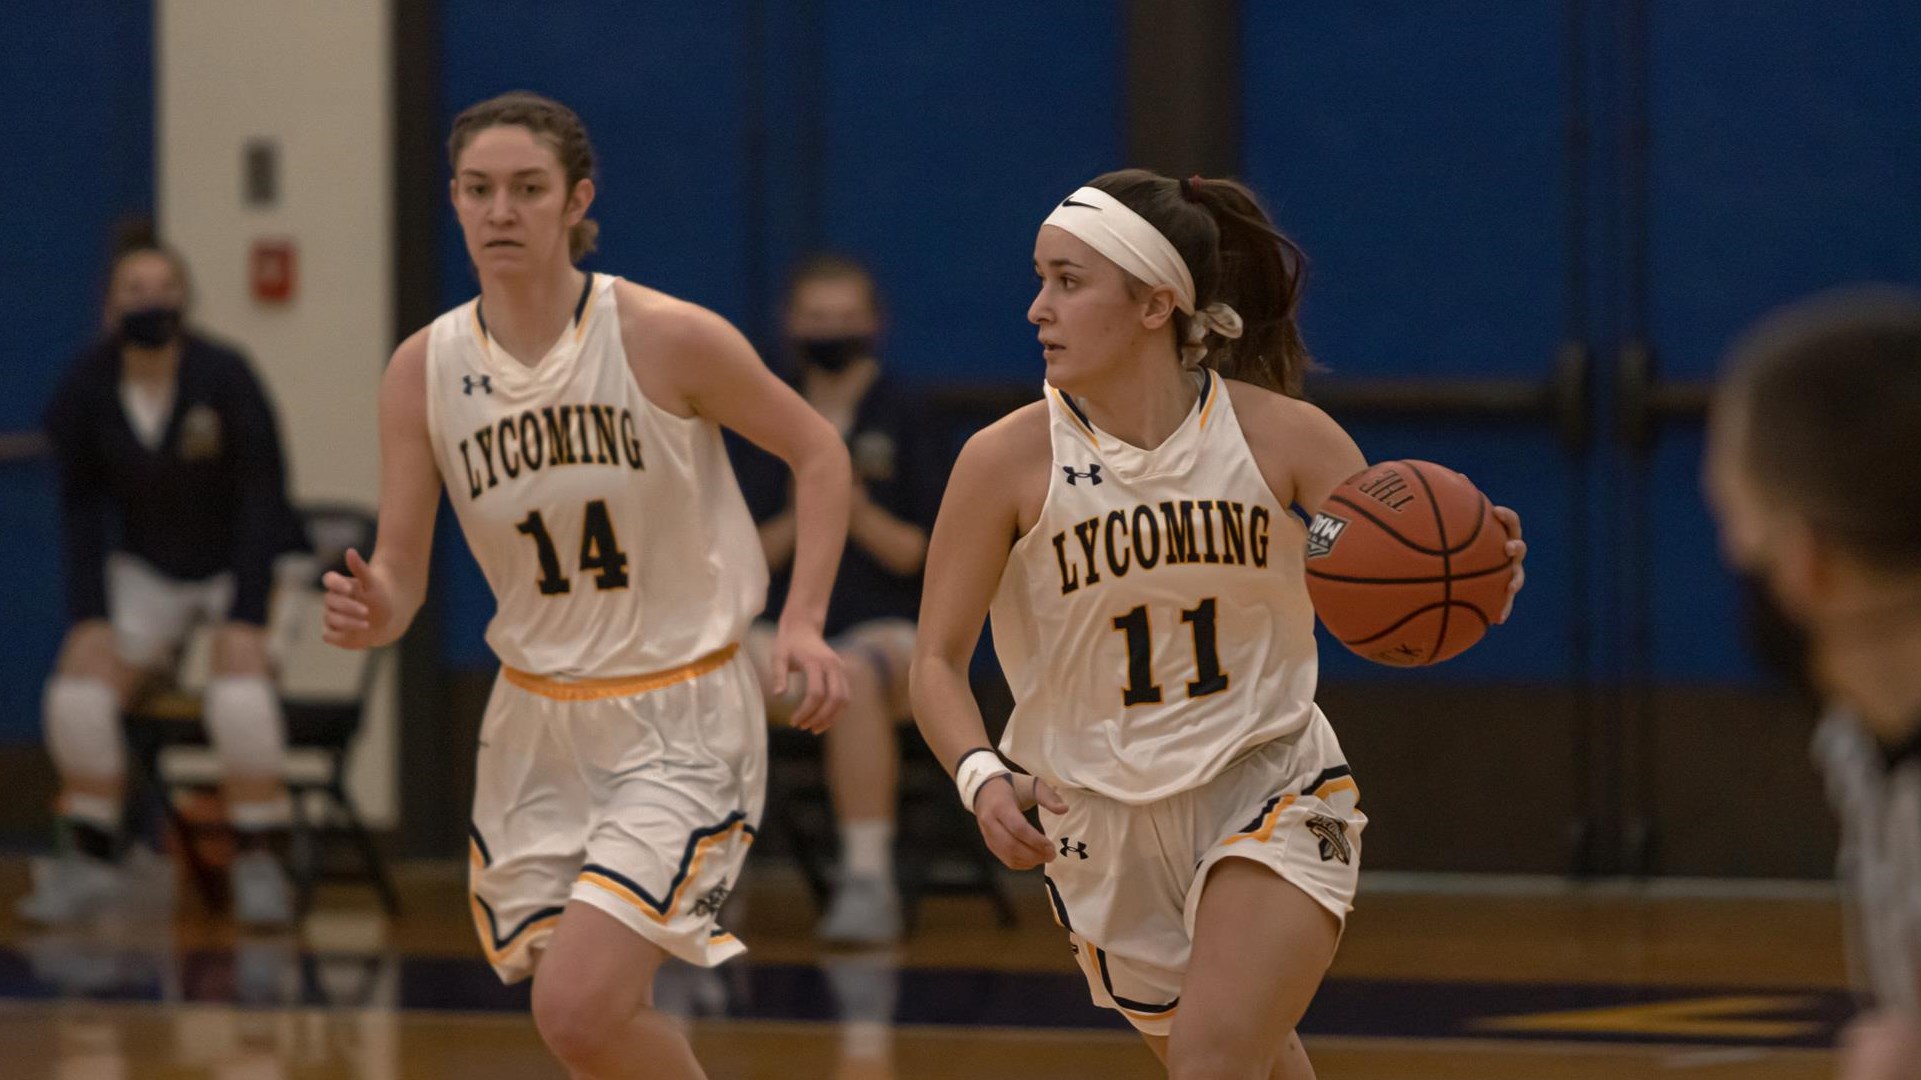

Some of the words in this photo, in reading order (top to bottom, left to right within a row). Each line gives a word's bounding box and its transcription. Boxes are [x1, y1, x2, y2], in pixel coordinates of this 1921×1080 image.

[459, 404, 646, 500] LYCOMING
[514, 498, 631, 596] 14
[1052, 500, 1270, 596] LYCOMING
[1111, 596, 1230, 707] 11
